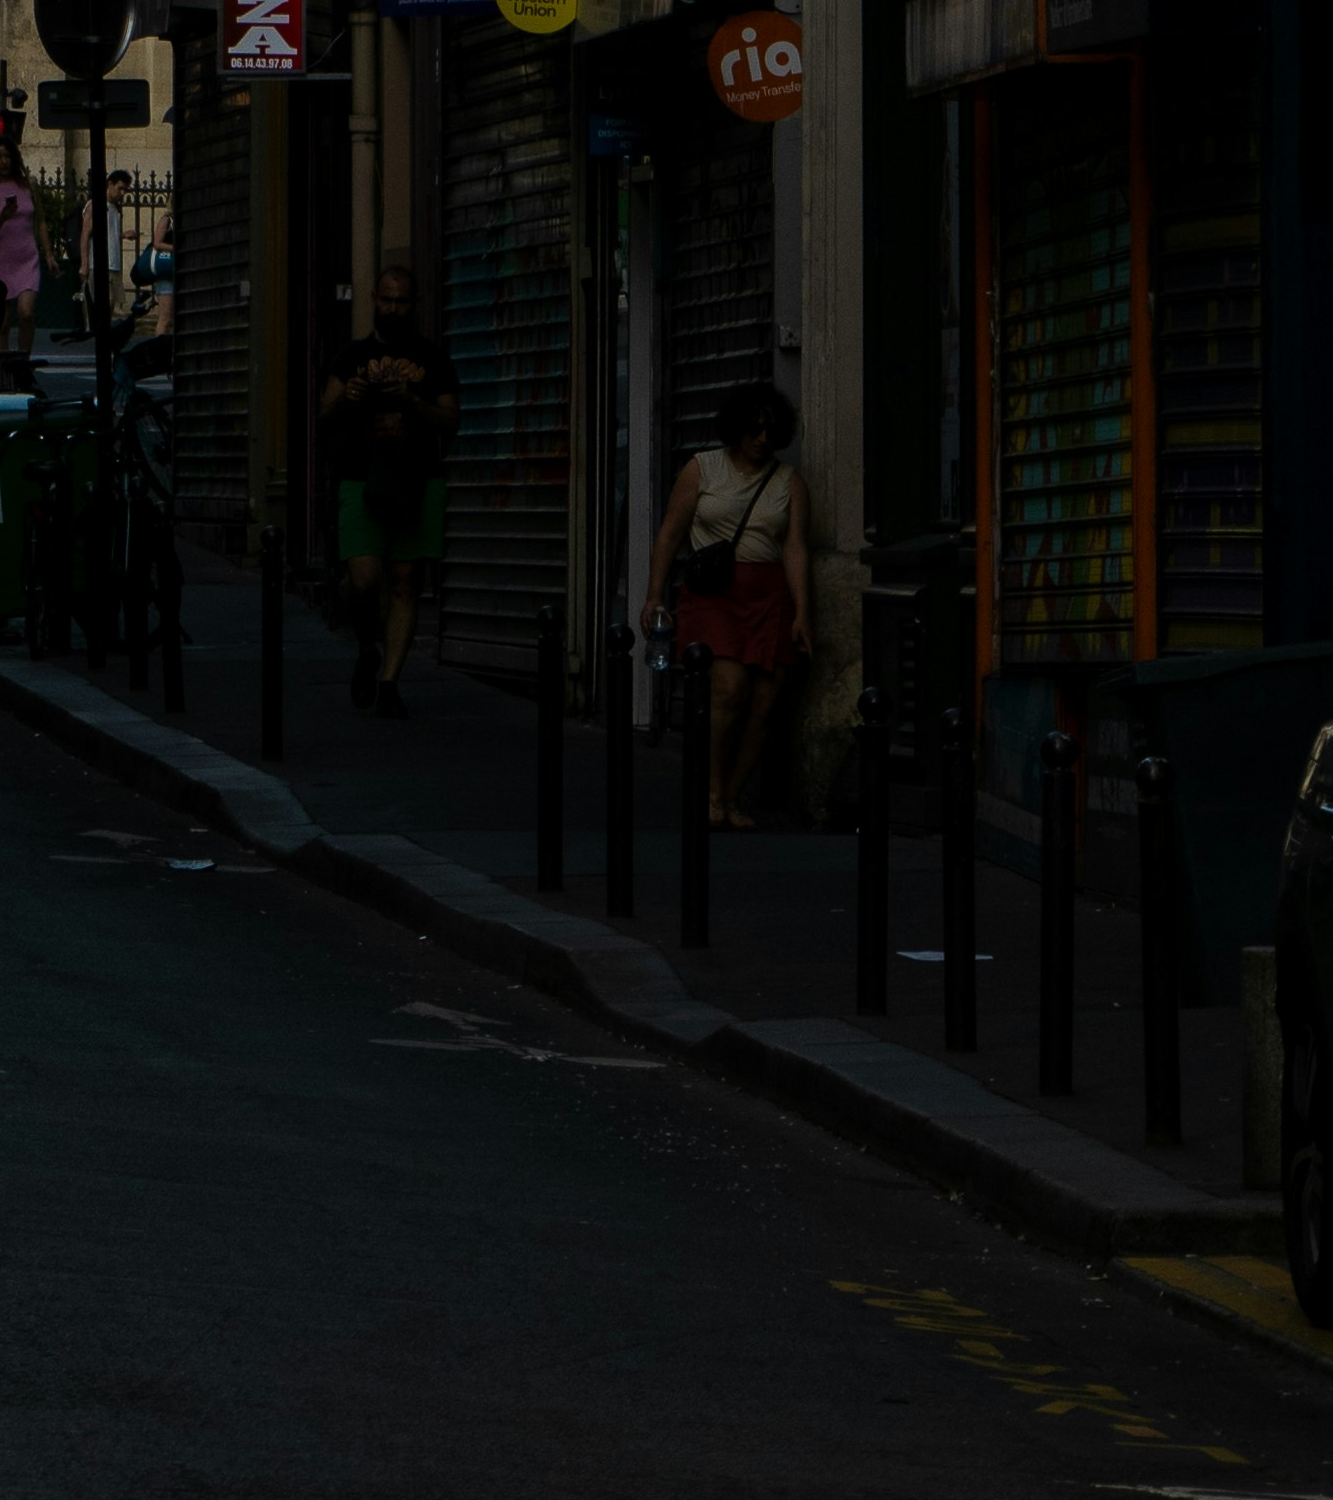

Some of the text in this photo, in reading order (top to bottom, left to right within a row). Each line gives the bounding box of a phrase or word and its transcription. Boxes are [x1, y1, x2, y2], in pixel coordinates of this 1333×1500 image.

[513, 4, 557, 18] Union
[720, 27, 803, 87] ria
[726, 79, 803, 104] Money Transfe
